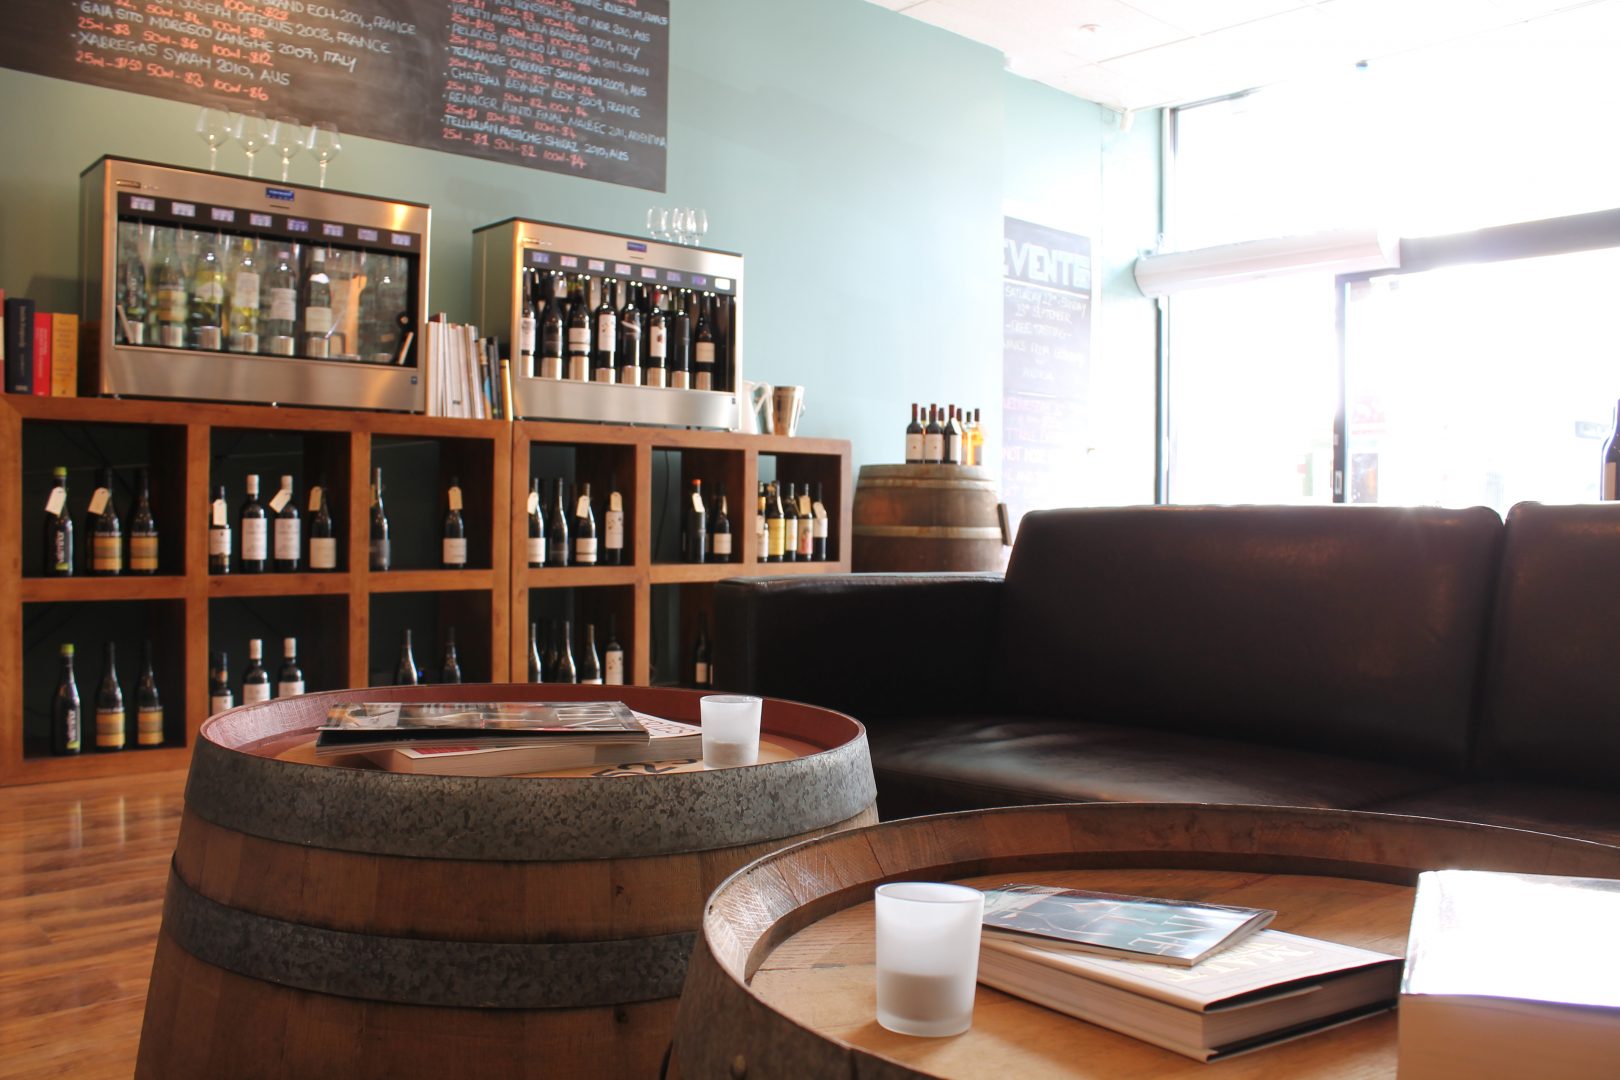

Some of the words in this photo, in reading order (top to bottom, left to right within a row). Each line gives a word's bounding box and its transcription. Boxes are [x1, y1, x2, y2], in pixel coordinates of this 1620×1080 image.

[373, 16, 416, 35] FRANCE
[215, 31, 275, 53] LANGHE
[323, 51, 357, 73] ITALY
[336, 31, 392, 54] FRANCE
[79, 31, 158, 57] XABREGAS
[163, 47, 212, 69] SYRAH
[260, 69, 290, 86] AUS
[606, 101, 642, 119] FRANCE
[544, 135, 580, 153] SHIRAZ
